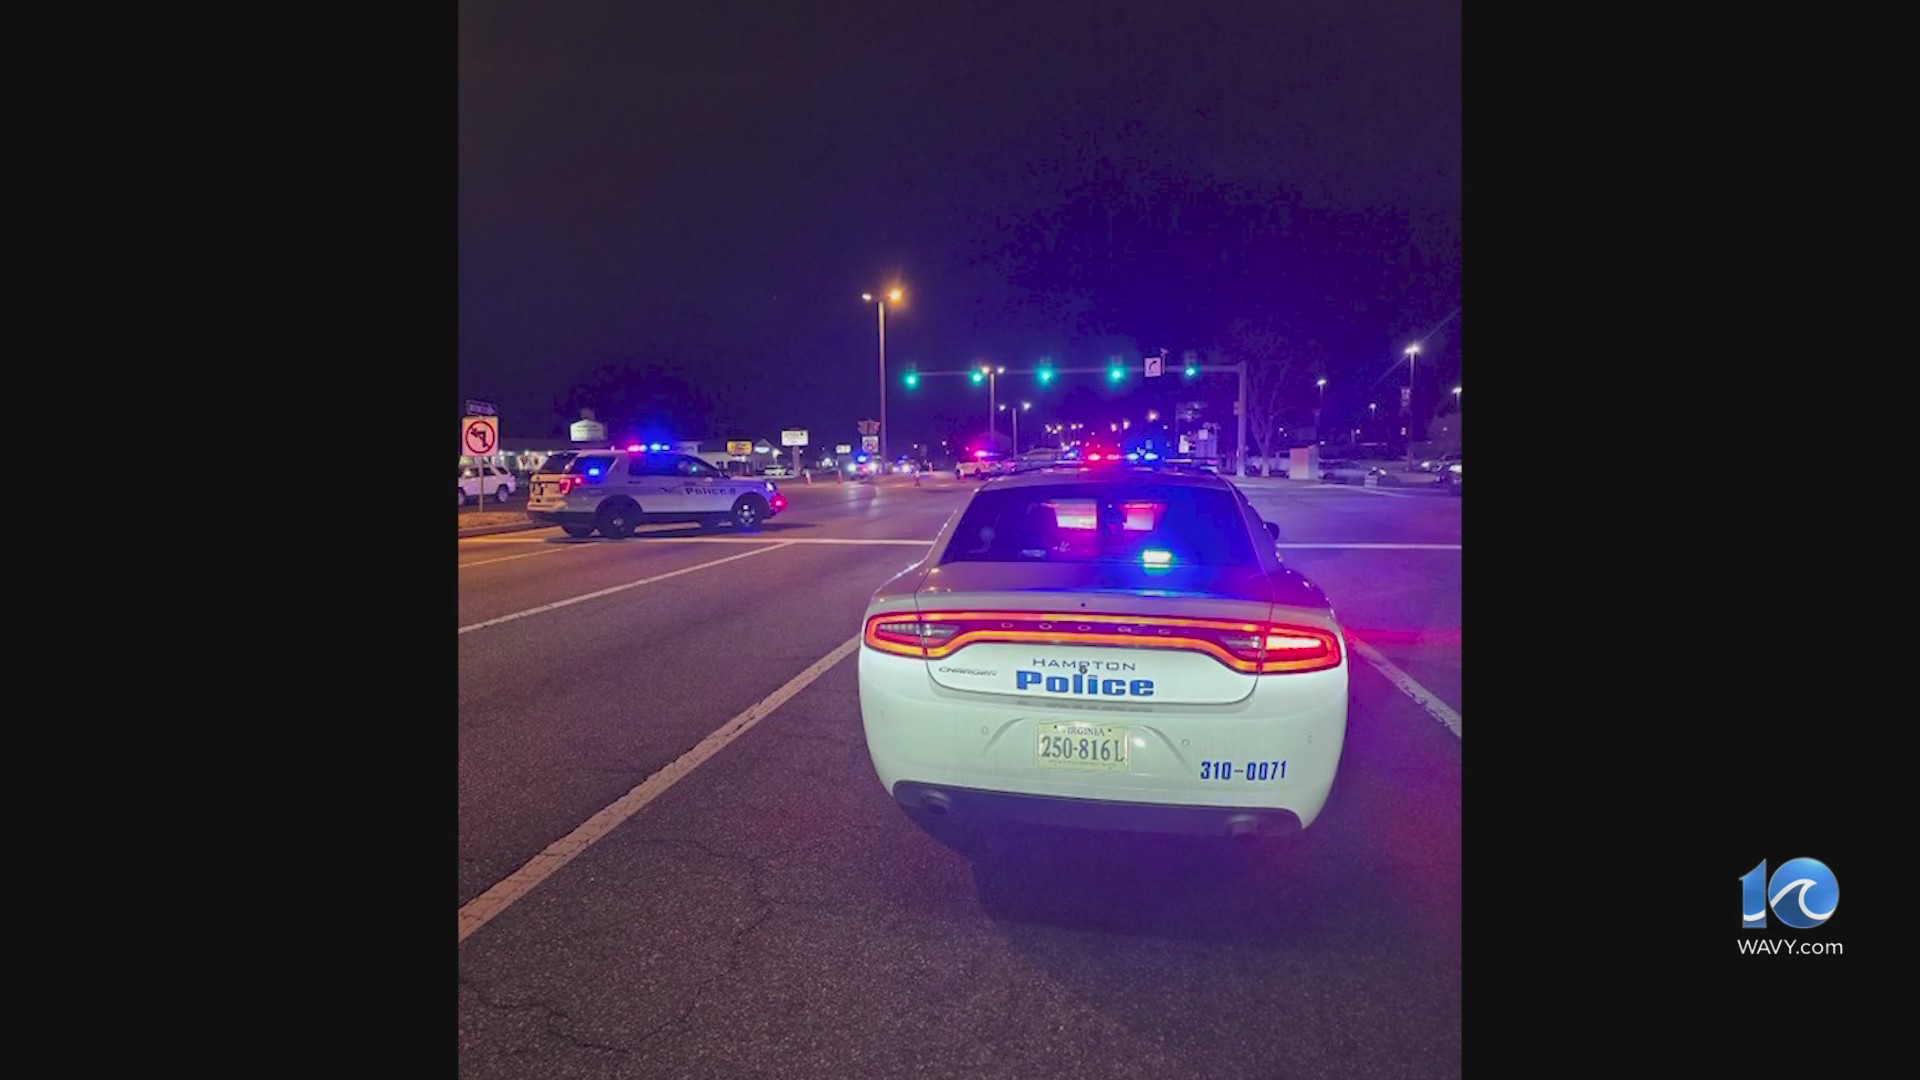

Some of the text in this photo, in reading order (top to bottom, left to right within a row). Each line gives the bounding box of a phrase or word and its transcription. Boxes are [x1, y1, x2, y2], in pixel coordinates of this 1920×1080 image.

[1032, 658, 1136, 671] HAMPTON
[1016, 670, 1155, 696] Police
[1061, 726, 1105, 737] VIRGINIA
[1200, 760, 1287, 781] 310-0071
